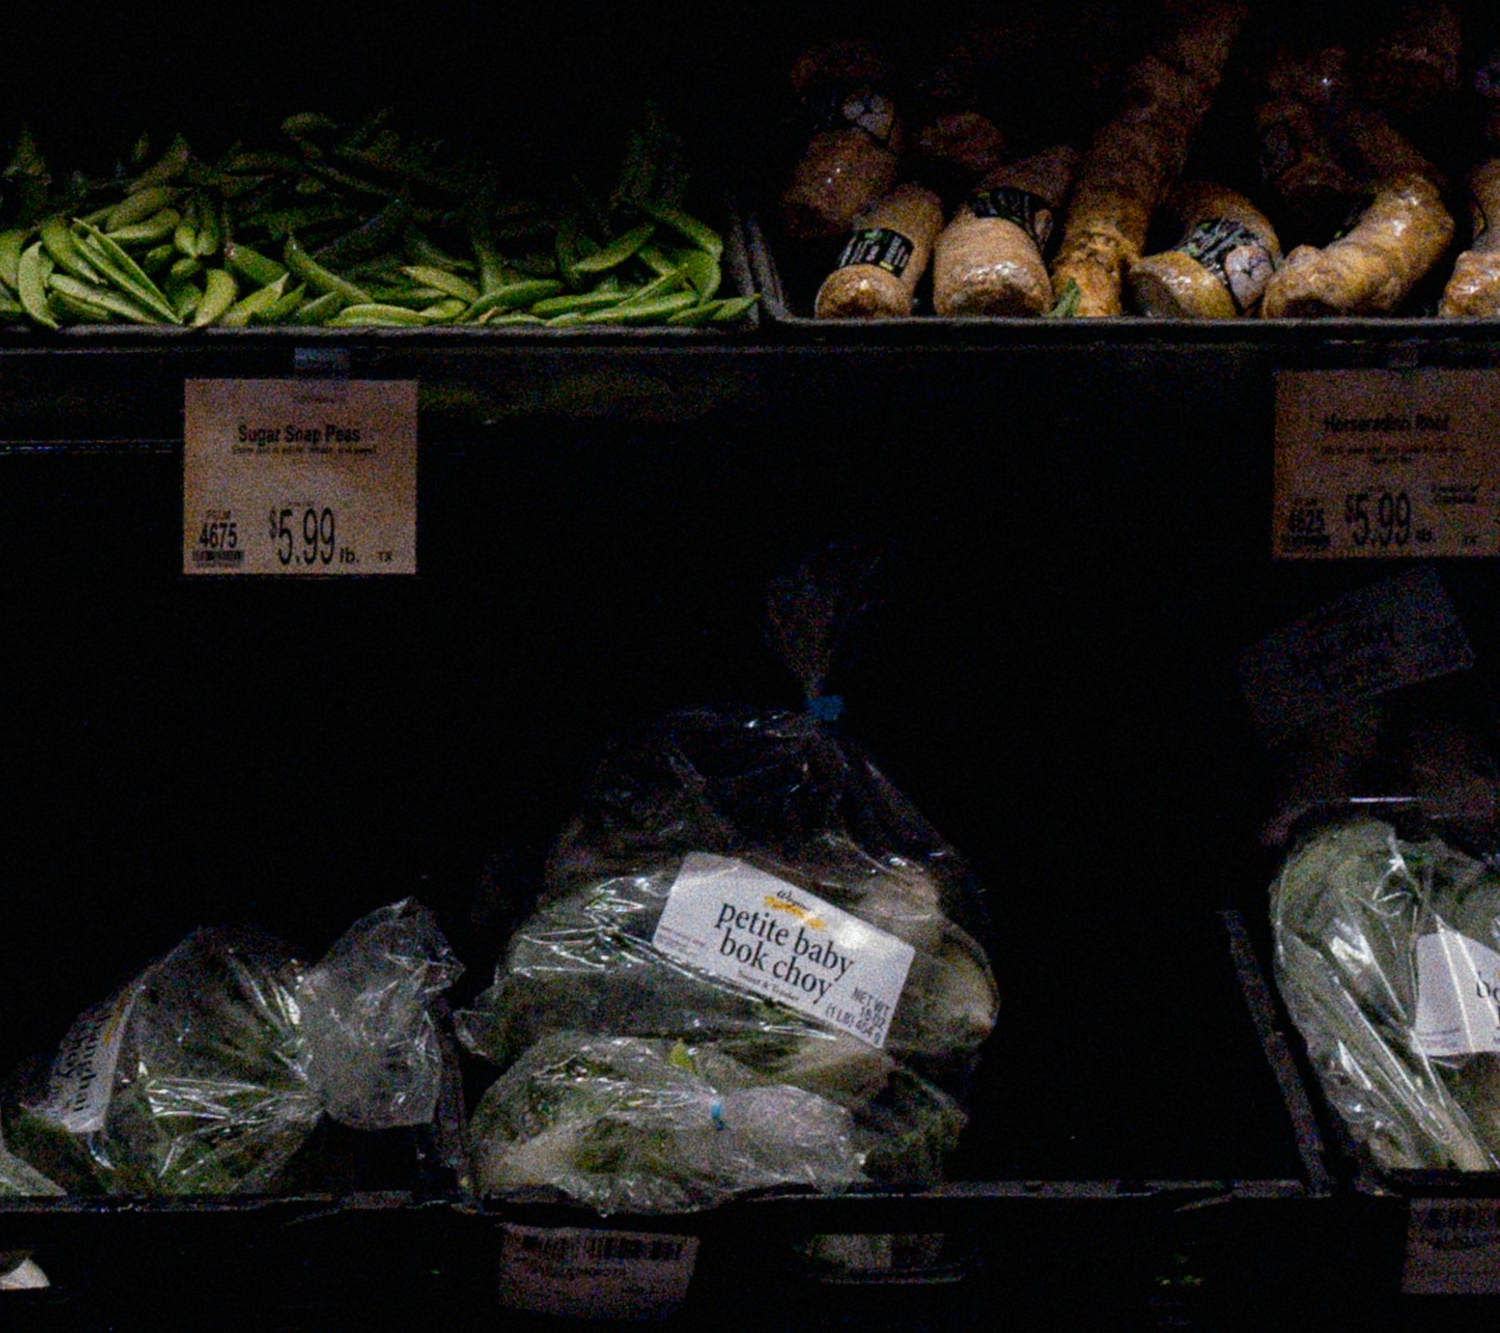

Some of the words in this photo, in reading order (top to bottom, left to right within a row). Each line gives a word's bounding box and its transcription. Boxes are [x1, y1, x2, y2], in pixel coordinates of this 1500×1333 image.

[238, 423, 281, 447] Sugar
[284, 424, 321, 446] Snap
[325, 423, 361, 443] Peas
[199, 522, 237, 549] 4675
[269, 506, 335, 566] $5.99
[339, 547, 360, 564] lb.
[1345, 490, 1411, 547] $5.99
[714, 902, 790, 947] petite
[794, 927, 856, 981] baby
[719, 926, 767, 973] bok
[771, 955, 833, 1005] choy
